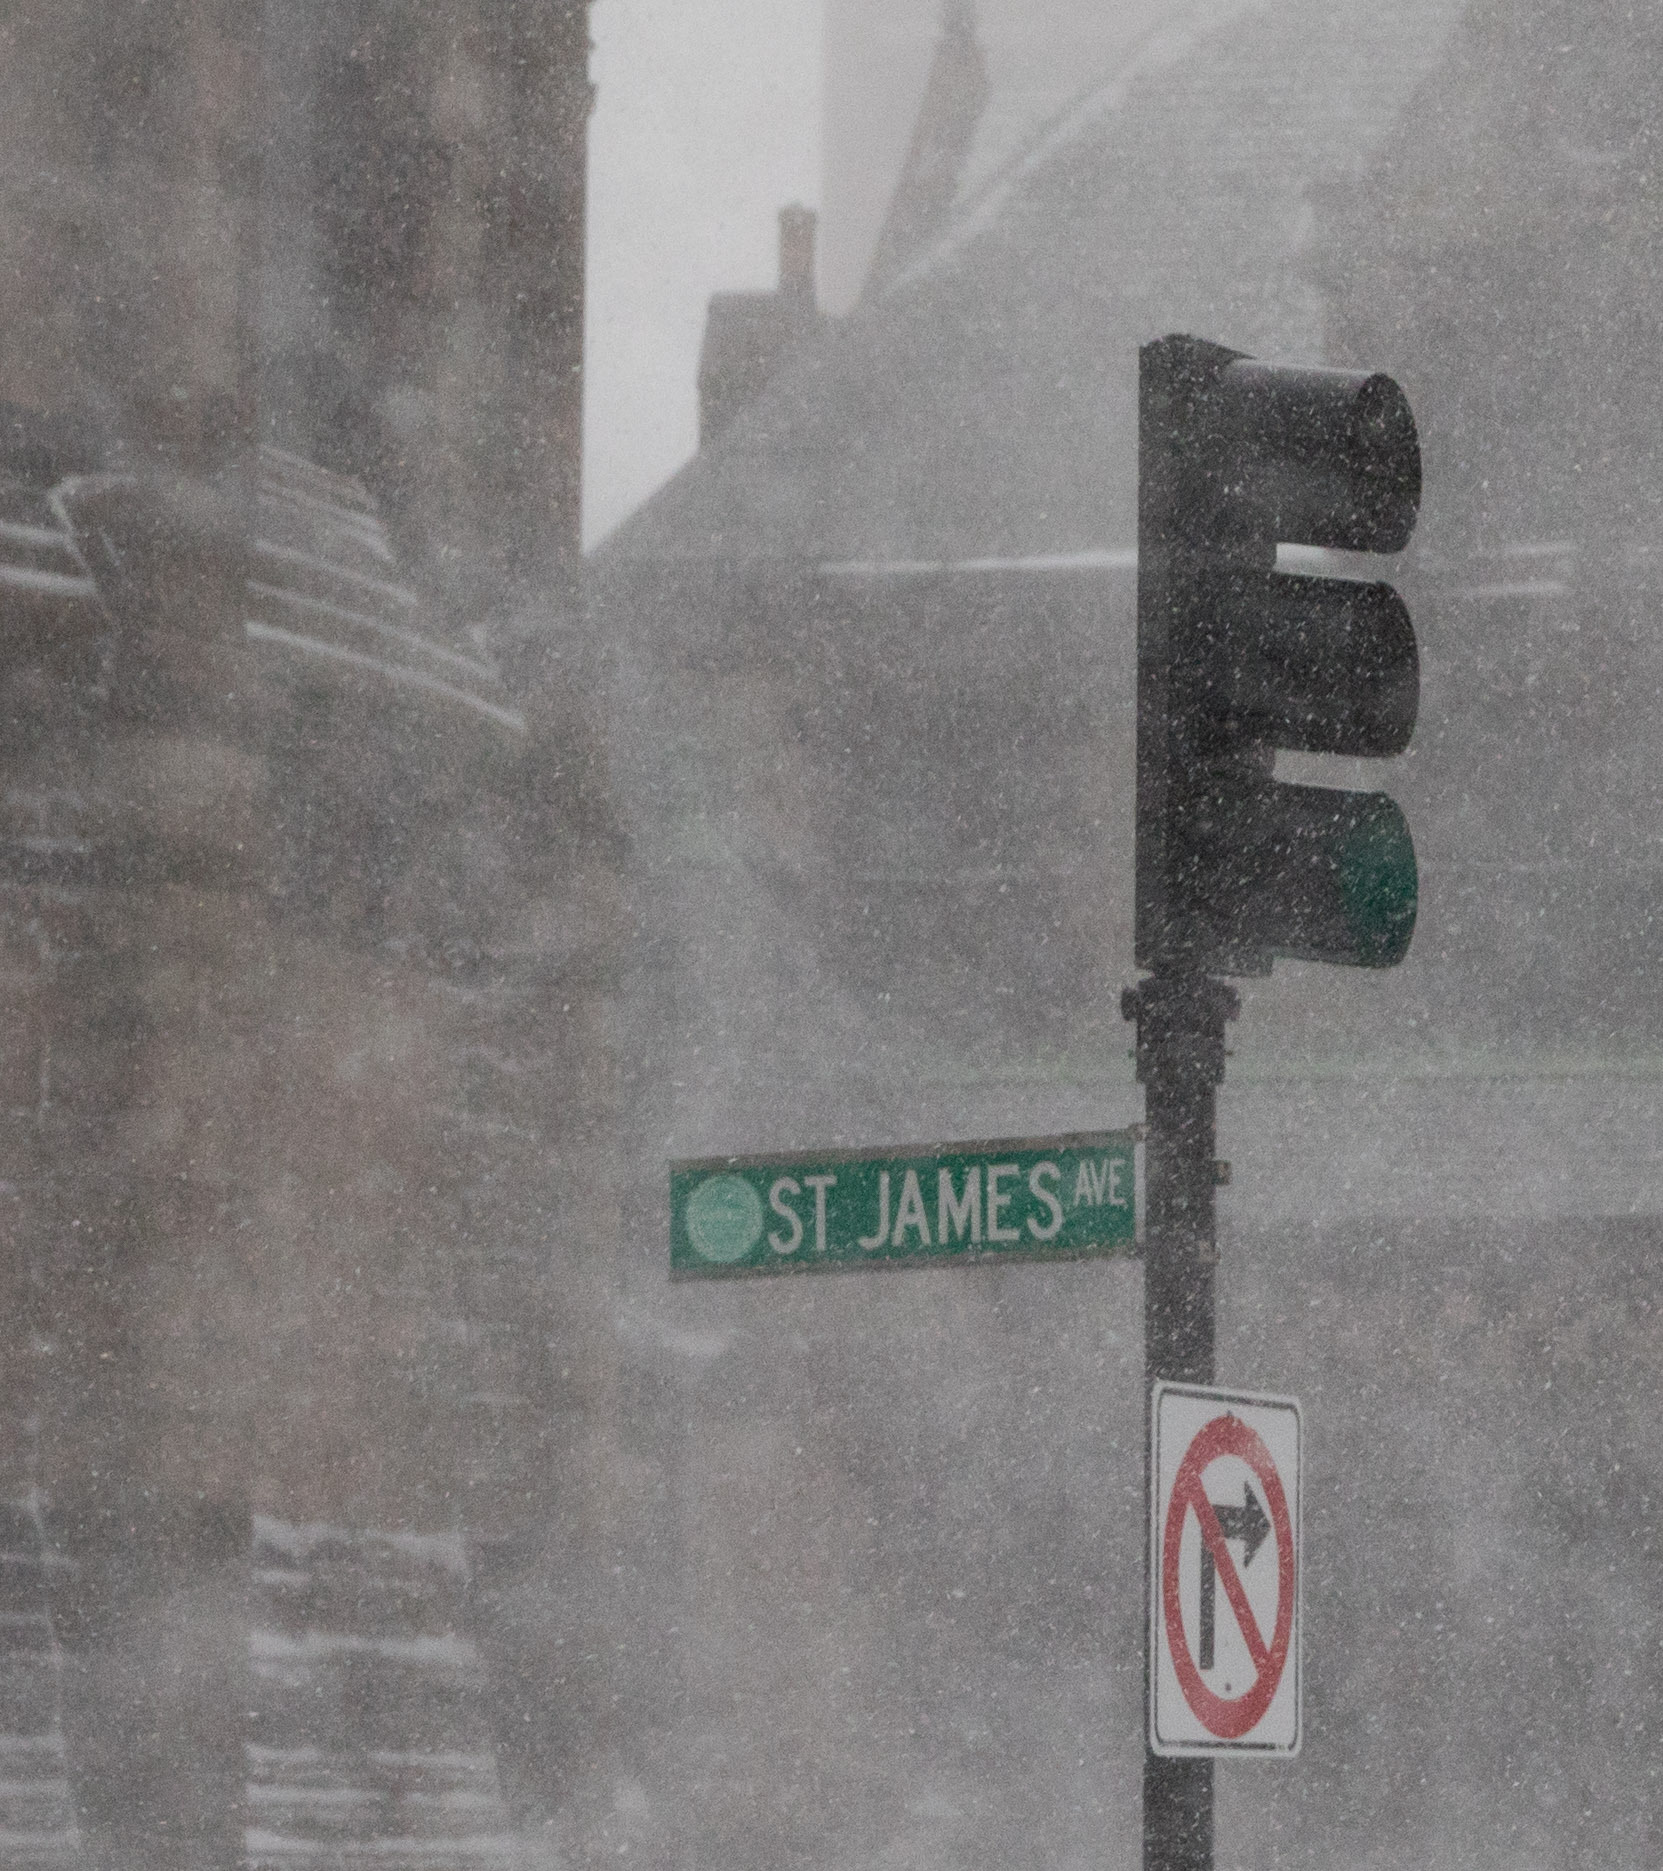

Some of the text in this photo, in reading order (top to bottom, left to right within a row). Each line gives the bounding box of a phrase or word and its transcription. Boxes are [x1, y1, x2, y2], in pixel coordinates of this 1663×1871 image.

[767, 1158, 1128, 1254] ST JAMES AVE
